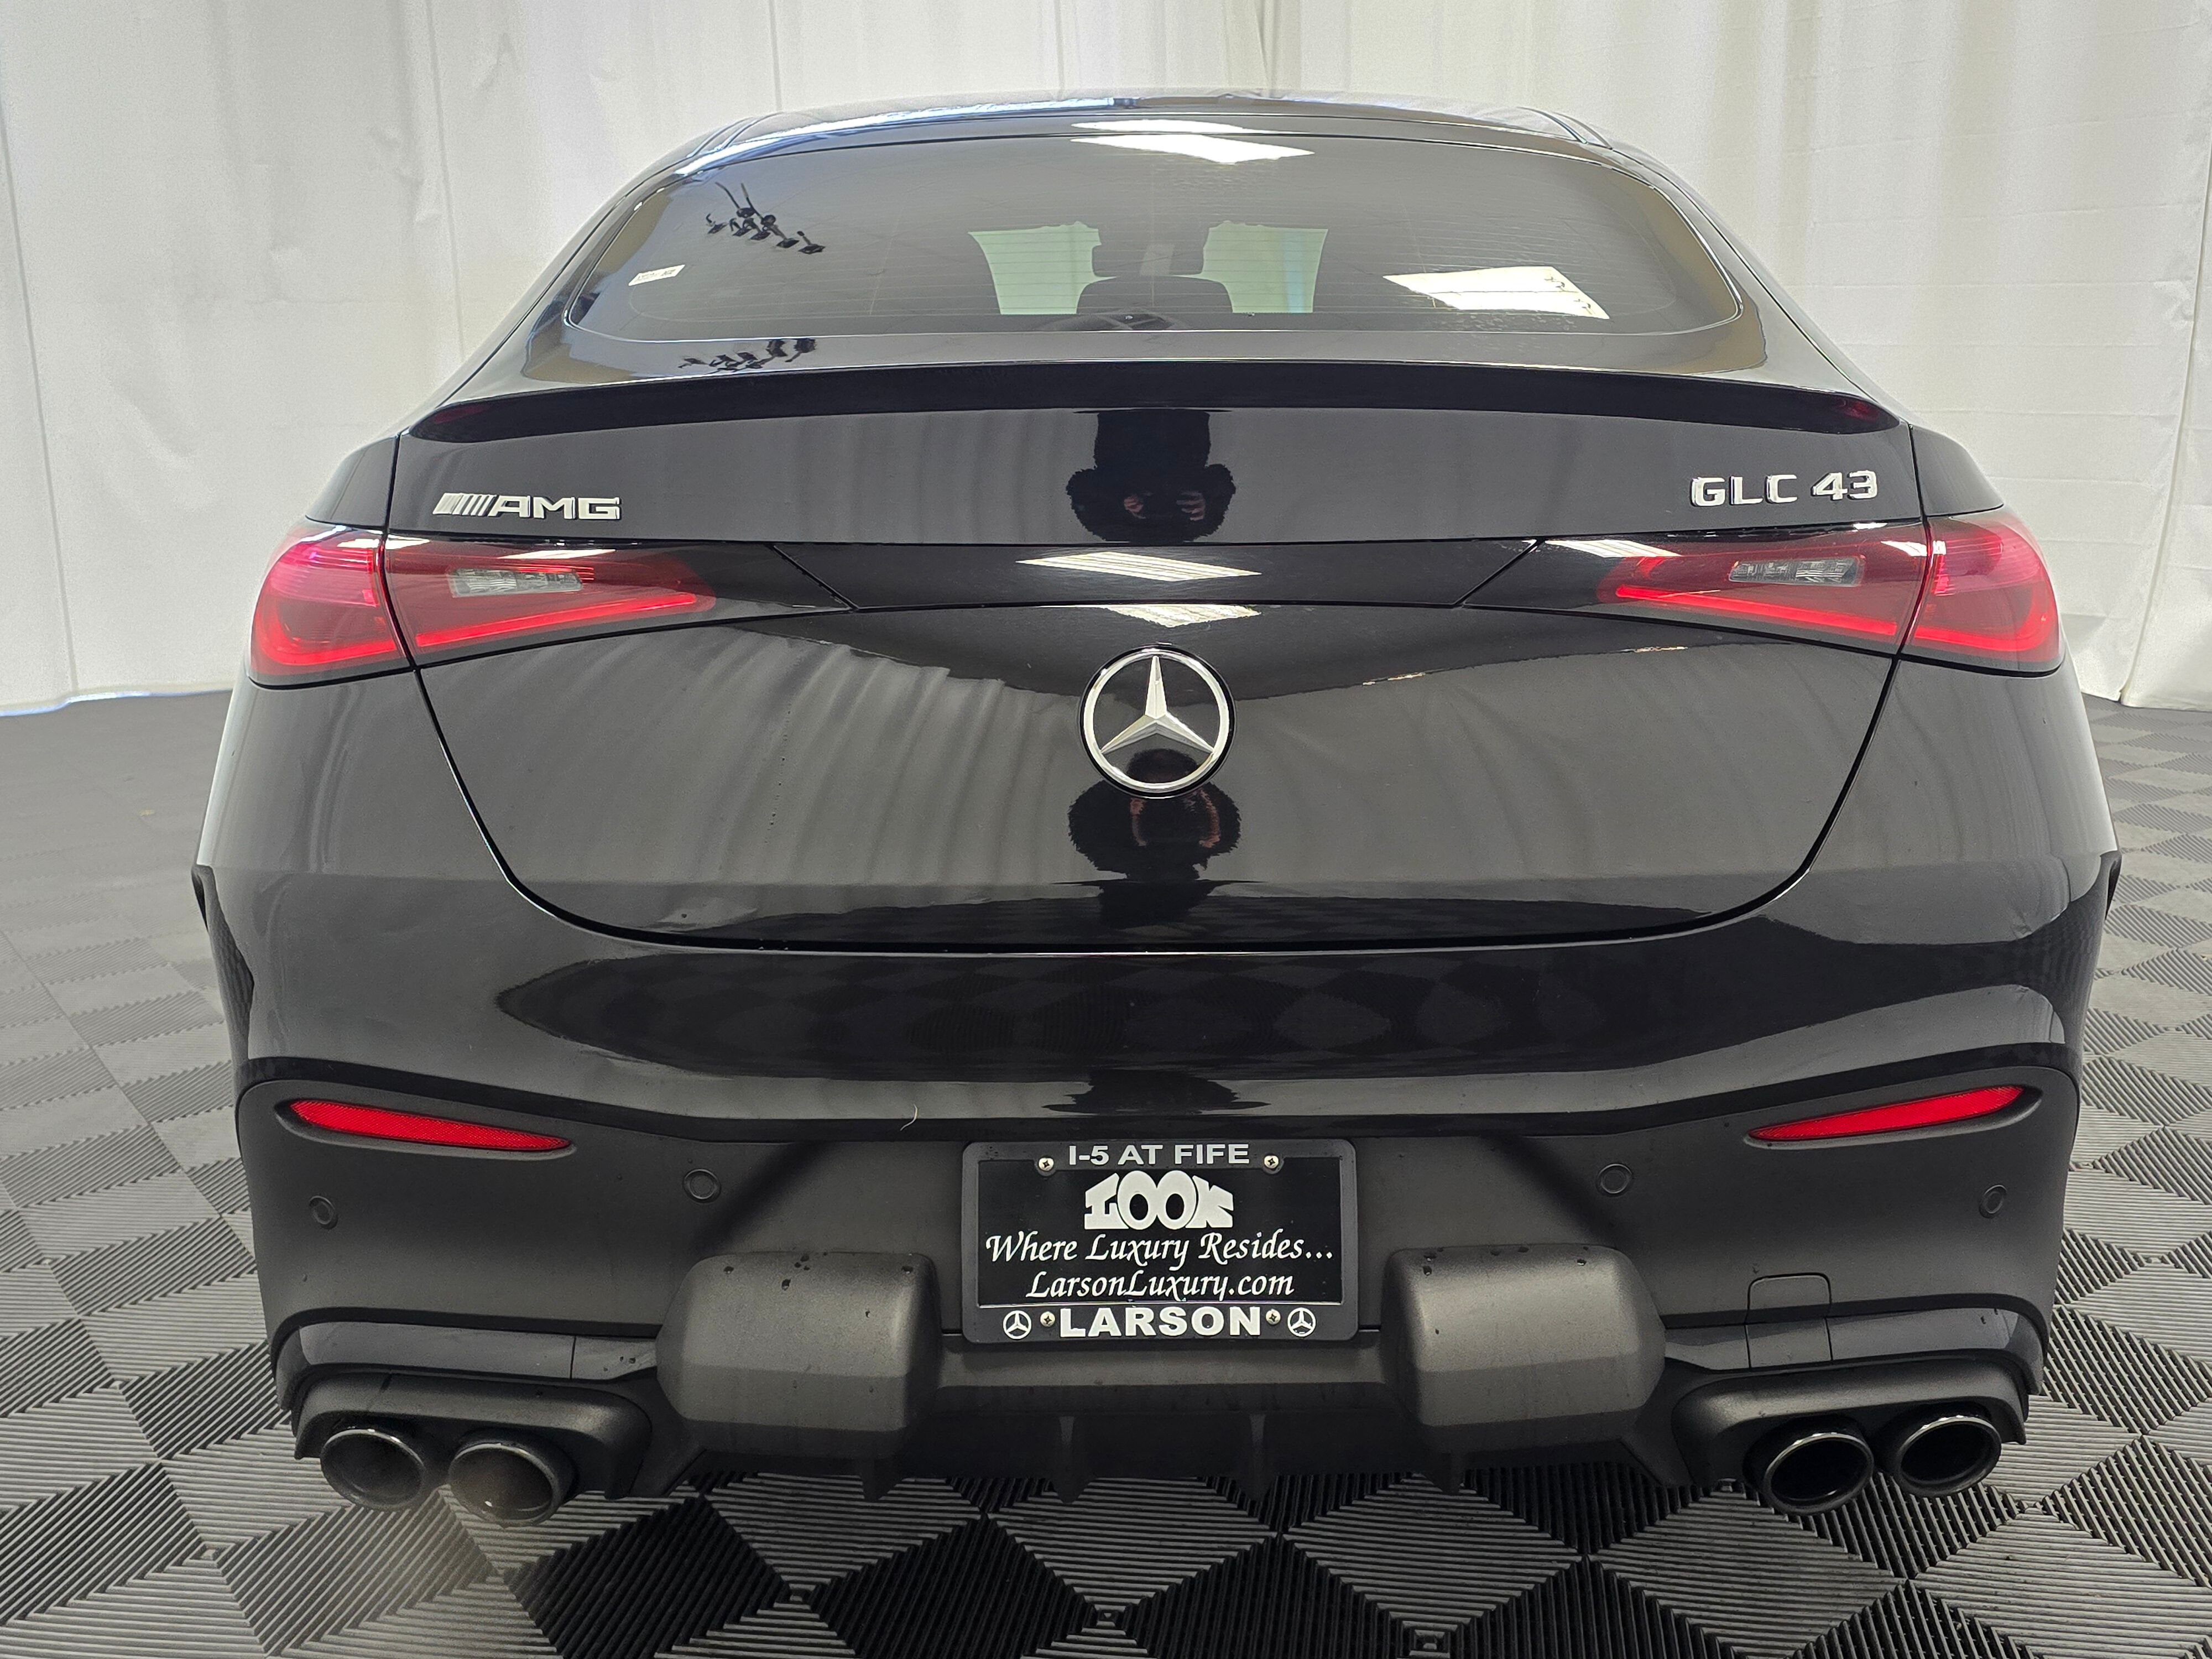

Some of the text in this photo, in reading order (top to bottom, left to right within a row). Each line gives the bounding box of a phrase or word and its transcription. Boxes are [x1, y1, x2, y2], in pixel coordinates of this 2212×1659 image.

[1692, 470, 1878, 507] GLC 43
[488, 495, 620, 520] AMG
[1068, 1144, 1250, 1165] I-5 AT FIFE
[1084, 1170, 1234, 1230] LOOK
[985, 1228, 1333, 1269] Where Luxury Resides...
[1025, 1270, 1295, 1302] LarsonLuxury.com
[1060, 1306, 1261, 1338] LARSON
